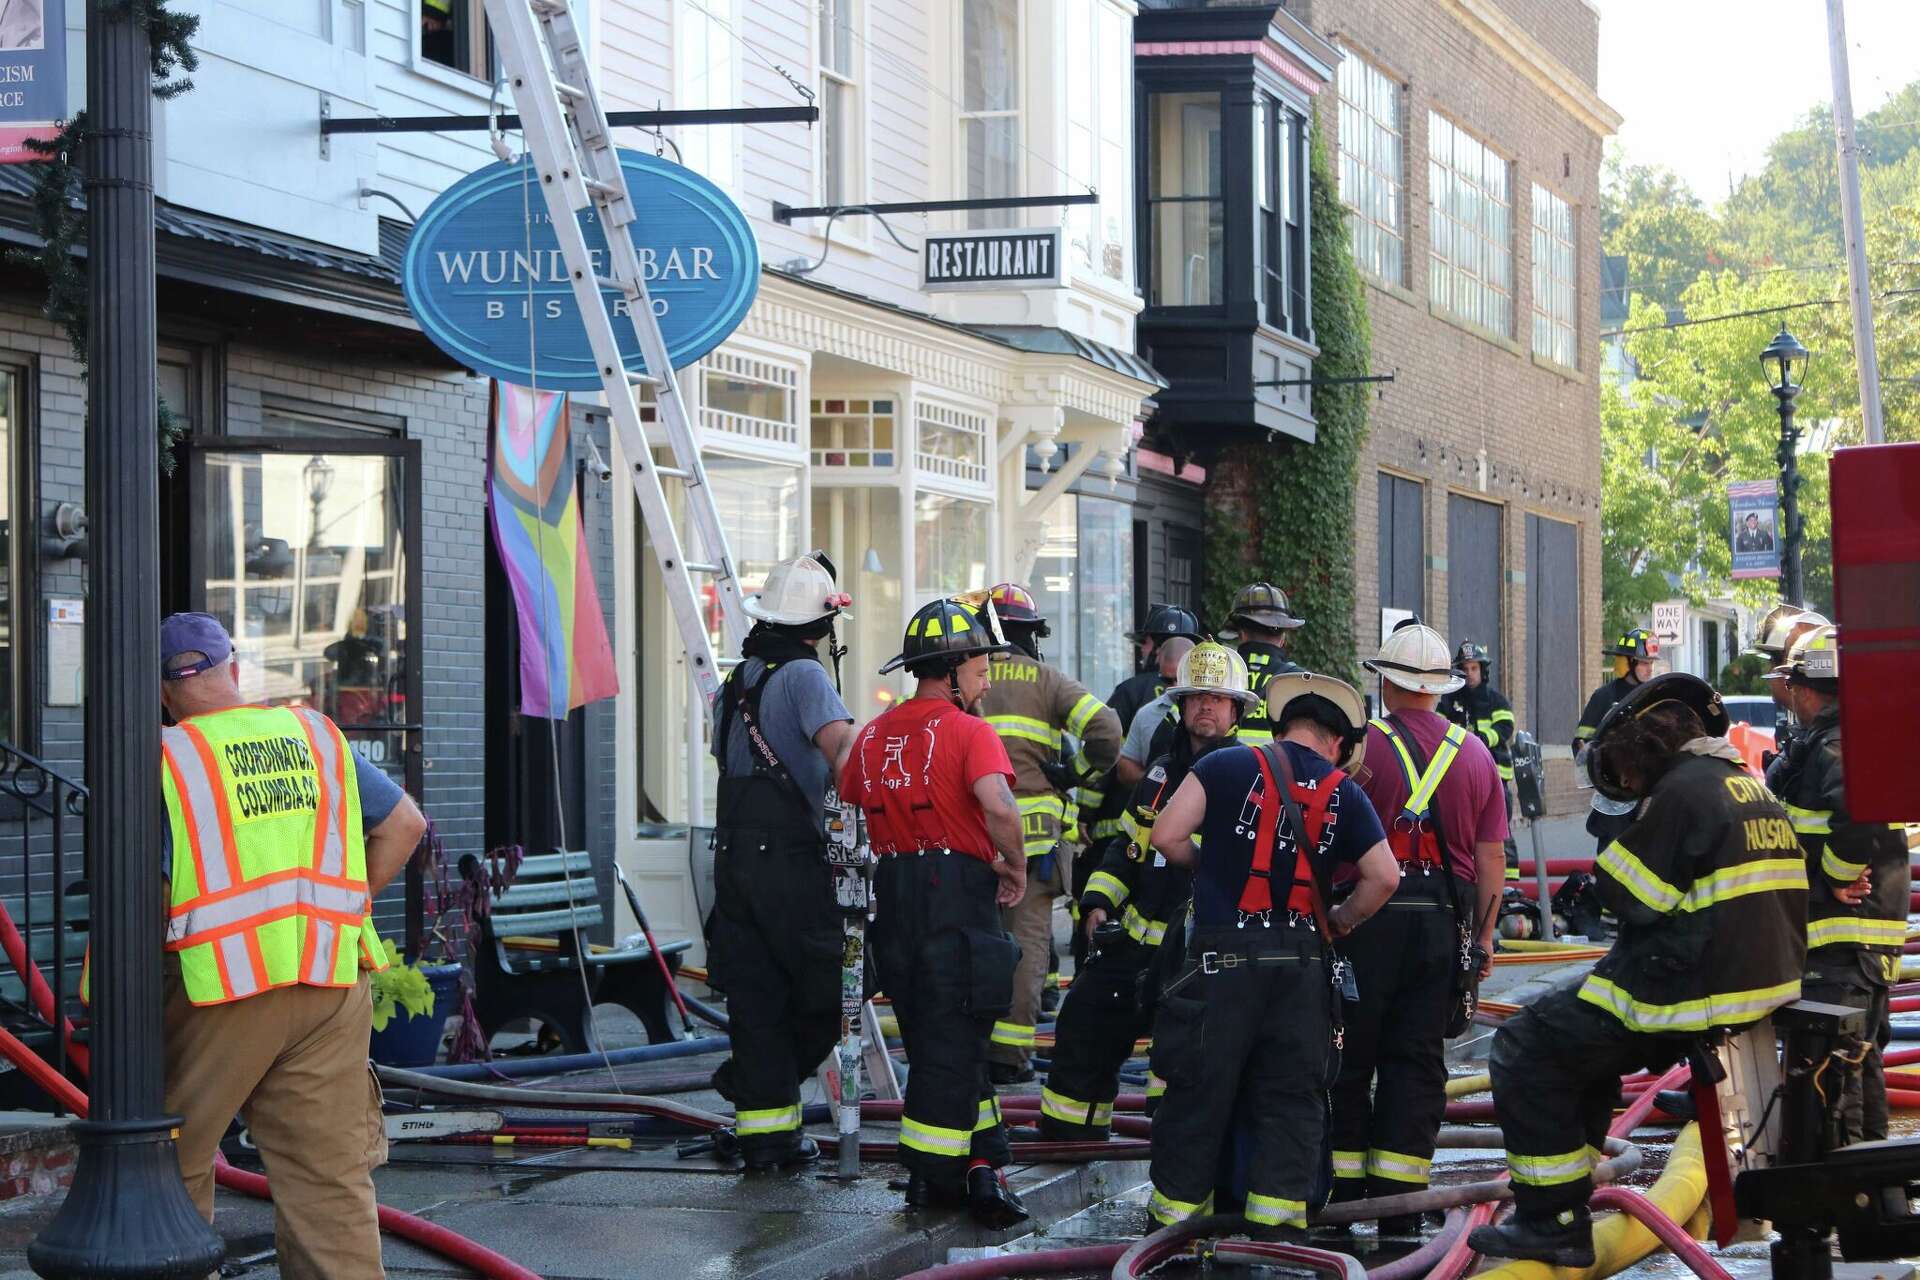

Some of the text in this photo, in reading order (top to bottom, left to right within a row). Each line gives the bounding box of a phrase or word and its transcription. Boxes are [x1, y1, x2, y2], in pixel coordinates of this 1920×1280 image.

[436, 246, 721, 284] WUNDEBAR
[928, 238, 1050, 278] RESTAURANT
[486, 298, 669, 320] BISRO
[1656, 619, 1681, 630] WAY
[1657, 607, 1680, 618] ONE
[224, 736, 315, 778] COORDINATOR
[236, 775, 305, 819] COLUMBIA
[401, 1121, 434, 1130] STIHL
